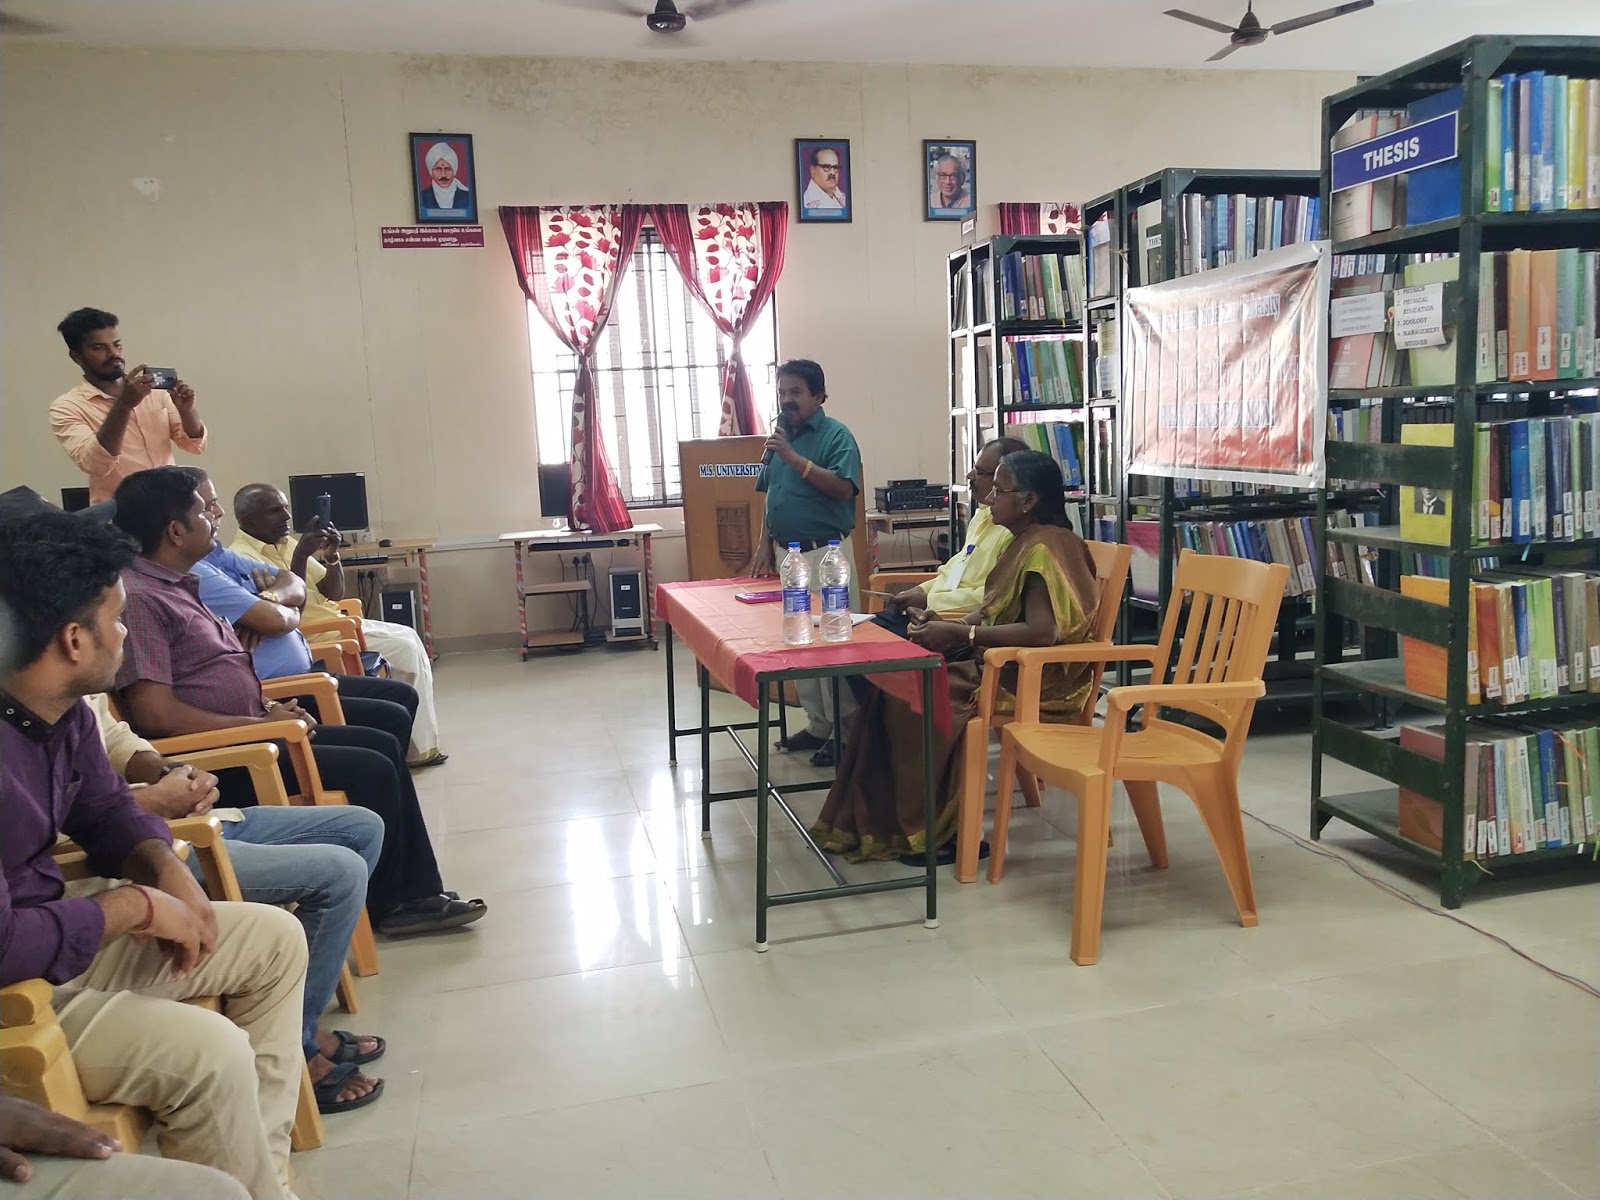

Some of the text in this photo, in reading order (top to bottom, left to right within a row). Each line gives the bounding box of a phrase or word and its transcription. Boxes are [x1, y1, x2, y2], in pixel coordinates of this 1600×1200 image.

[1363, 136, 1420, 172] THESIS
[1149, 237, 1161, 247] THE
[1402, 286, 1425, 295] PHYSICS
[1402, 297, 1429, 305] PHYSICAL
[1403, 306, 1434, 315] EDUCATION
[1402, 317, 1428, 326] ZOOLOGY
[1402, 327, 1440, 336] MANAGEMENT
[699, 463, 764, 477] M.S. UNIVERSITY
